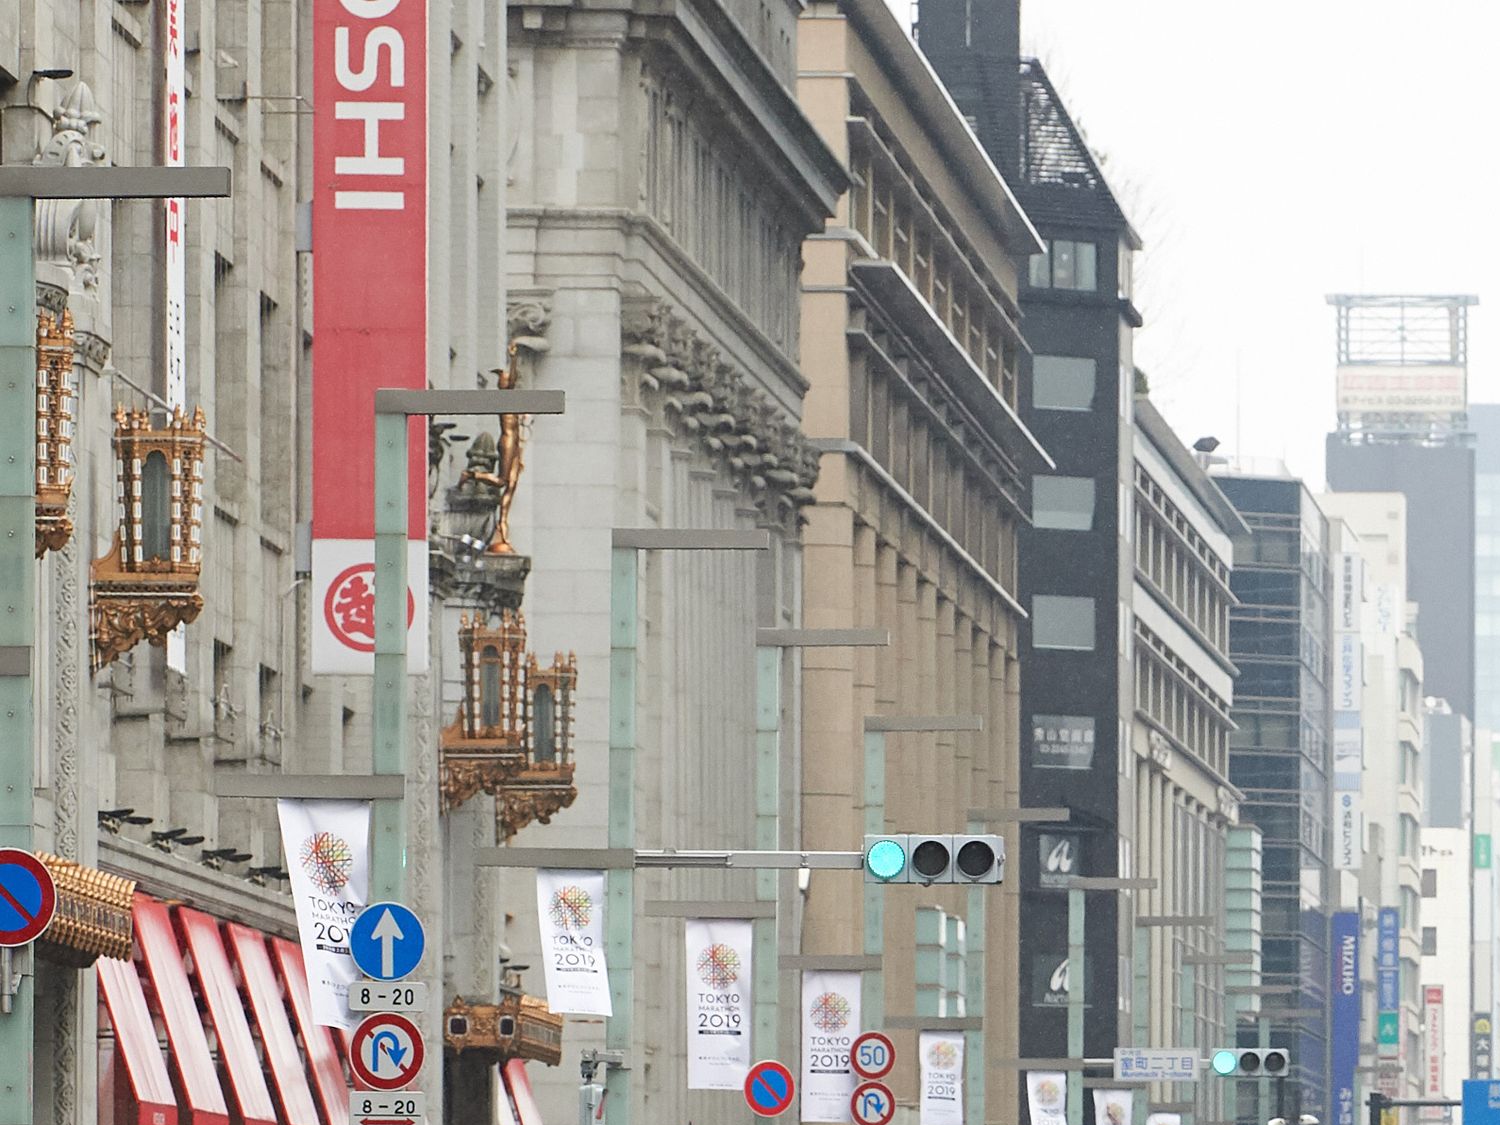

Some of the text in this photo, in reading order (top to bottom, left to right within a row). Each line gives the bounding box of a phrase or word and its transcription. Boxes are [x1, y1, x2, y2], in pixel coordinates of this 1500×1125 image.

[311, 911, 356, 924] MARATHO
[314, 922, 352, 945] 201
[554, 953, 596, 967] 2019
[1342, 934, 1355, 995] MIZUHO
[697, 993, 741, 1004] TOKYO
[697, 1013, 742, 1029] 2019
[810, 1036, 850, 1046] TOKYO
[810, 1055, 850, 1068] 2019
[859, 1045, 886, 1067] 50
[1121, 1057, 1193, 1070] 室町二丁目
[928, 1072, 957, 1080] TOKYO
[927, 1085, 957, 1096] 2019
